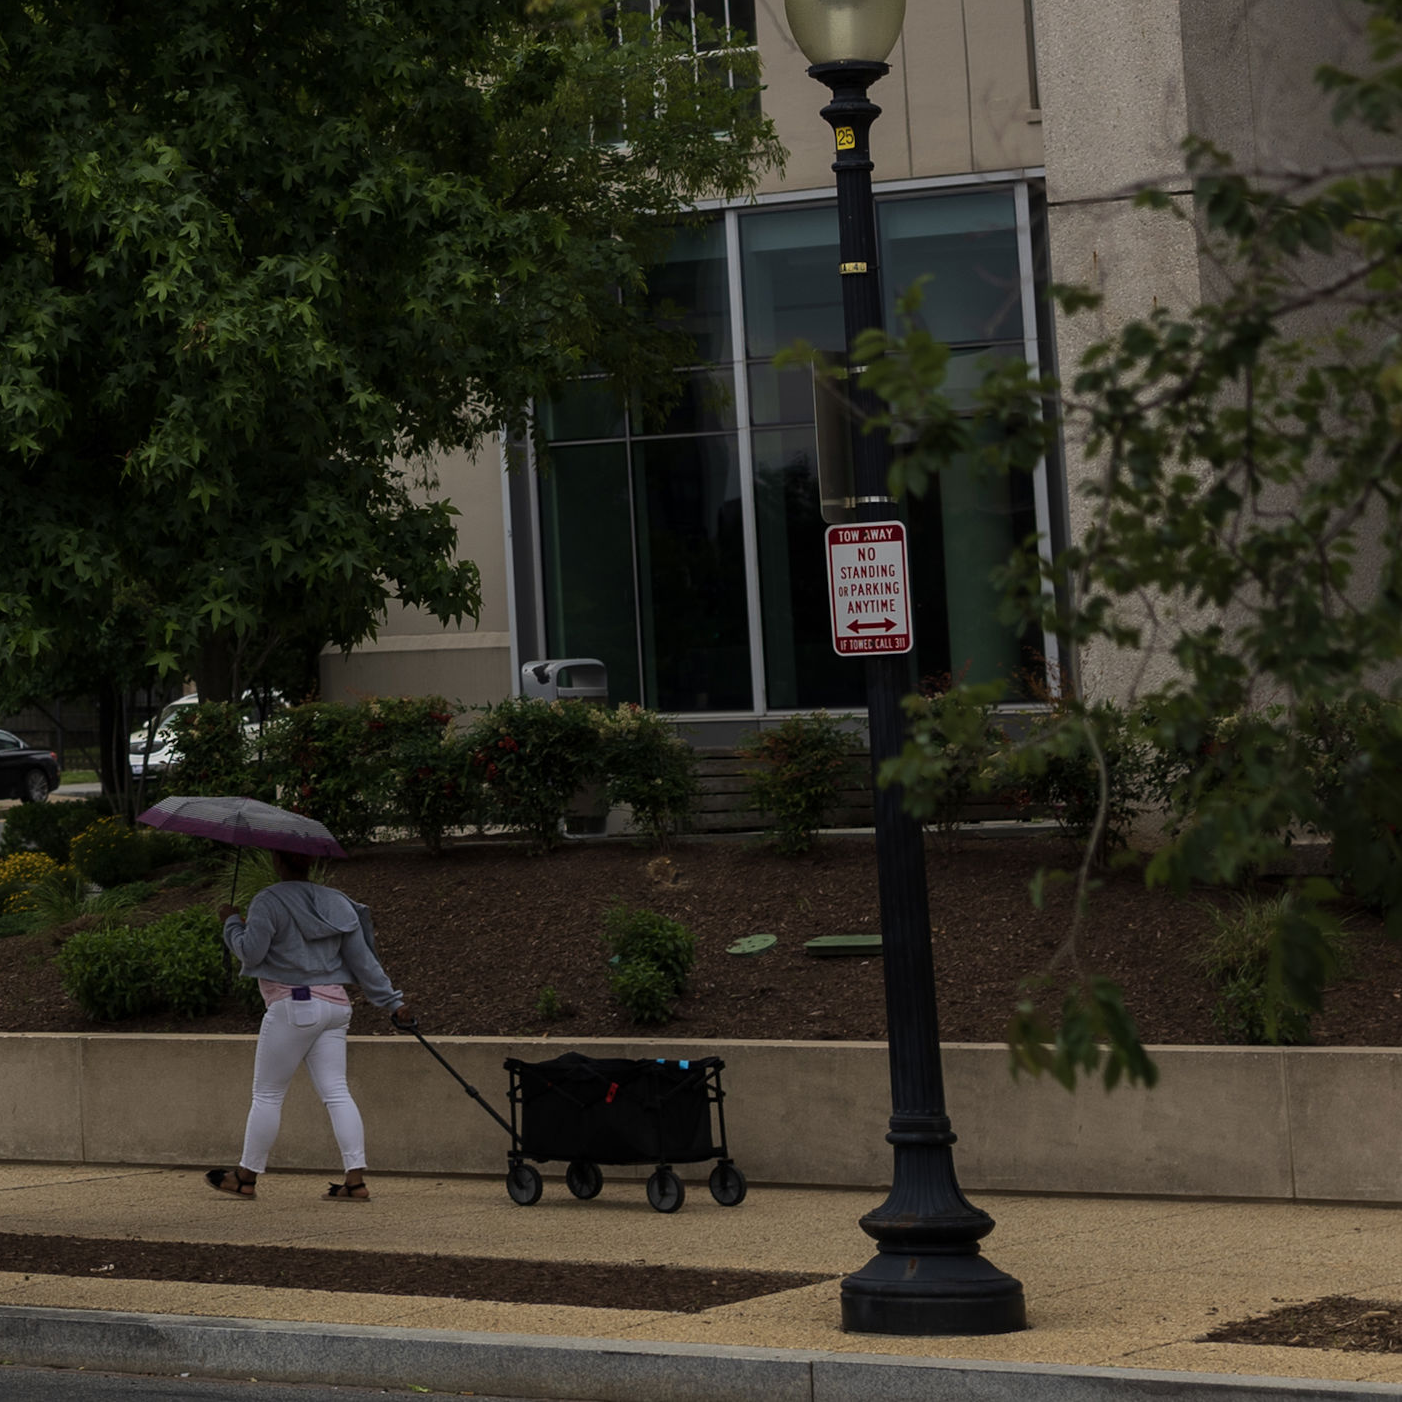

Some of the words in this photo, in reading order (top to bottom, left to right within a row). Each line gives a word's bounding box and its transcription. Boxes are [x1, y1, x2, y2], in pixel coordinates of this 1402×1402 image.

[837, 128, 854, 146] 25
[838, 530, 860, 543] TOW
[863, 528, 894, 541] AWAY
[857, 547, 876, 562] NO
[840, 564, 895, 580] STANDING
[838, 586, 849, 597] OR
[851, 582, 900, 597] PARKING
[847, 599, 896, 614] ANYTIME
[840, 639, 847, 651] IF
[849, 638, 874, 650] TOWED
[874, 638, 893, 650] CALL
[894, 637, 906, 648] 311
